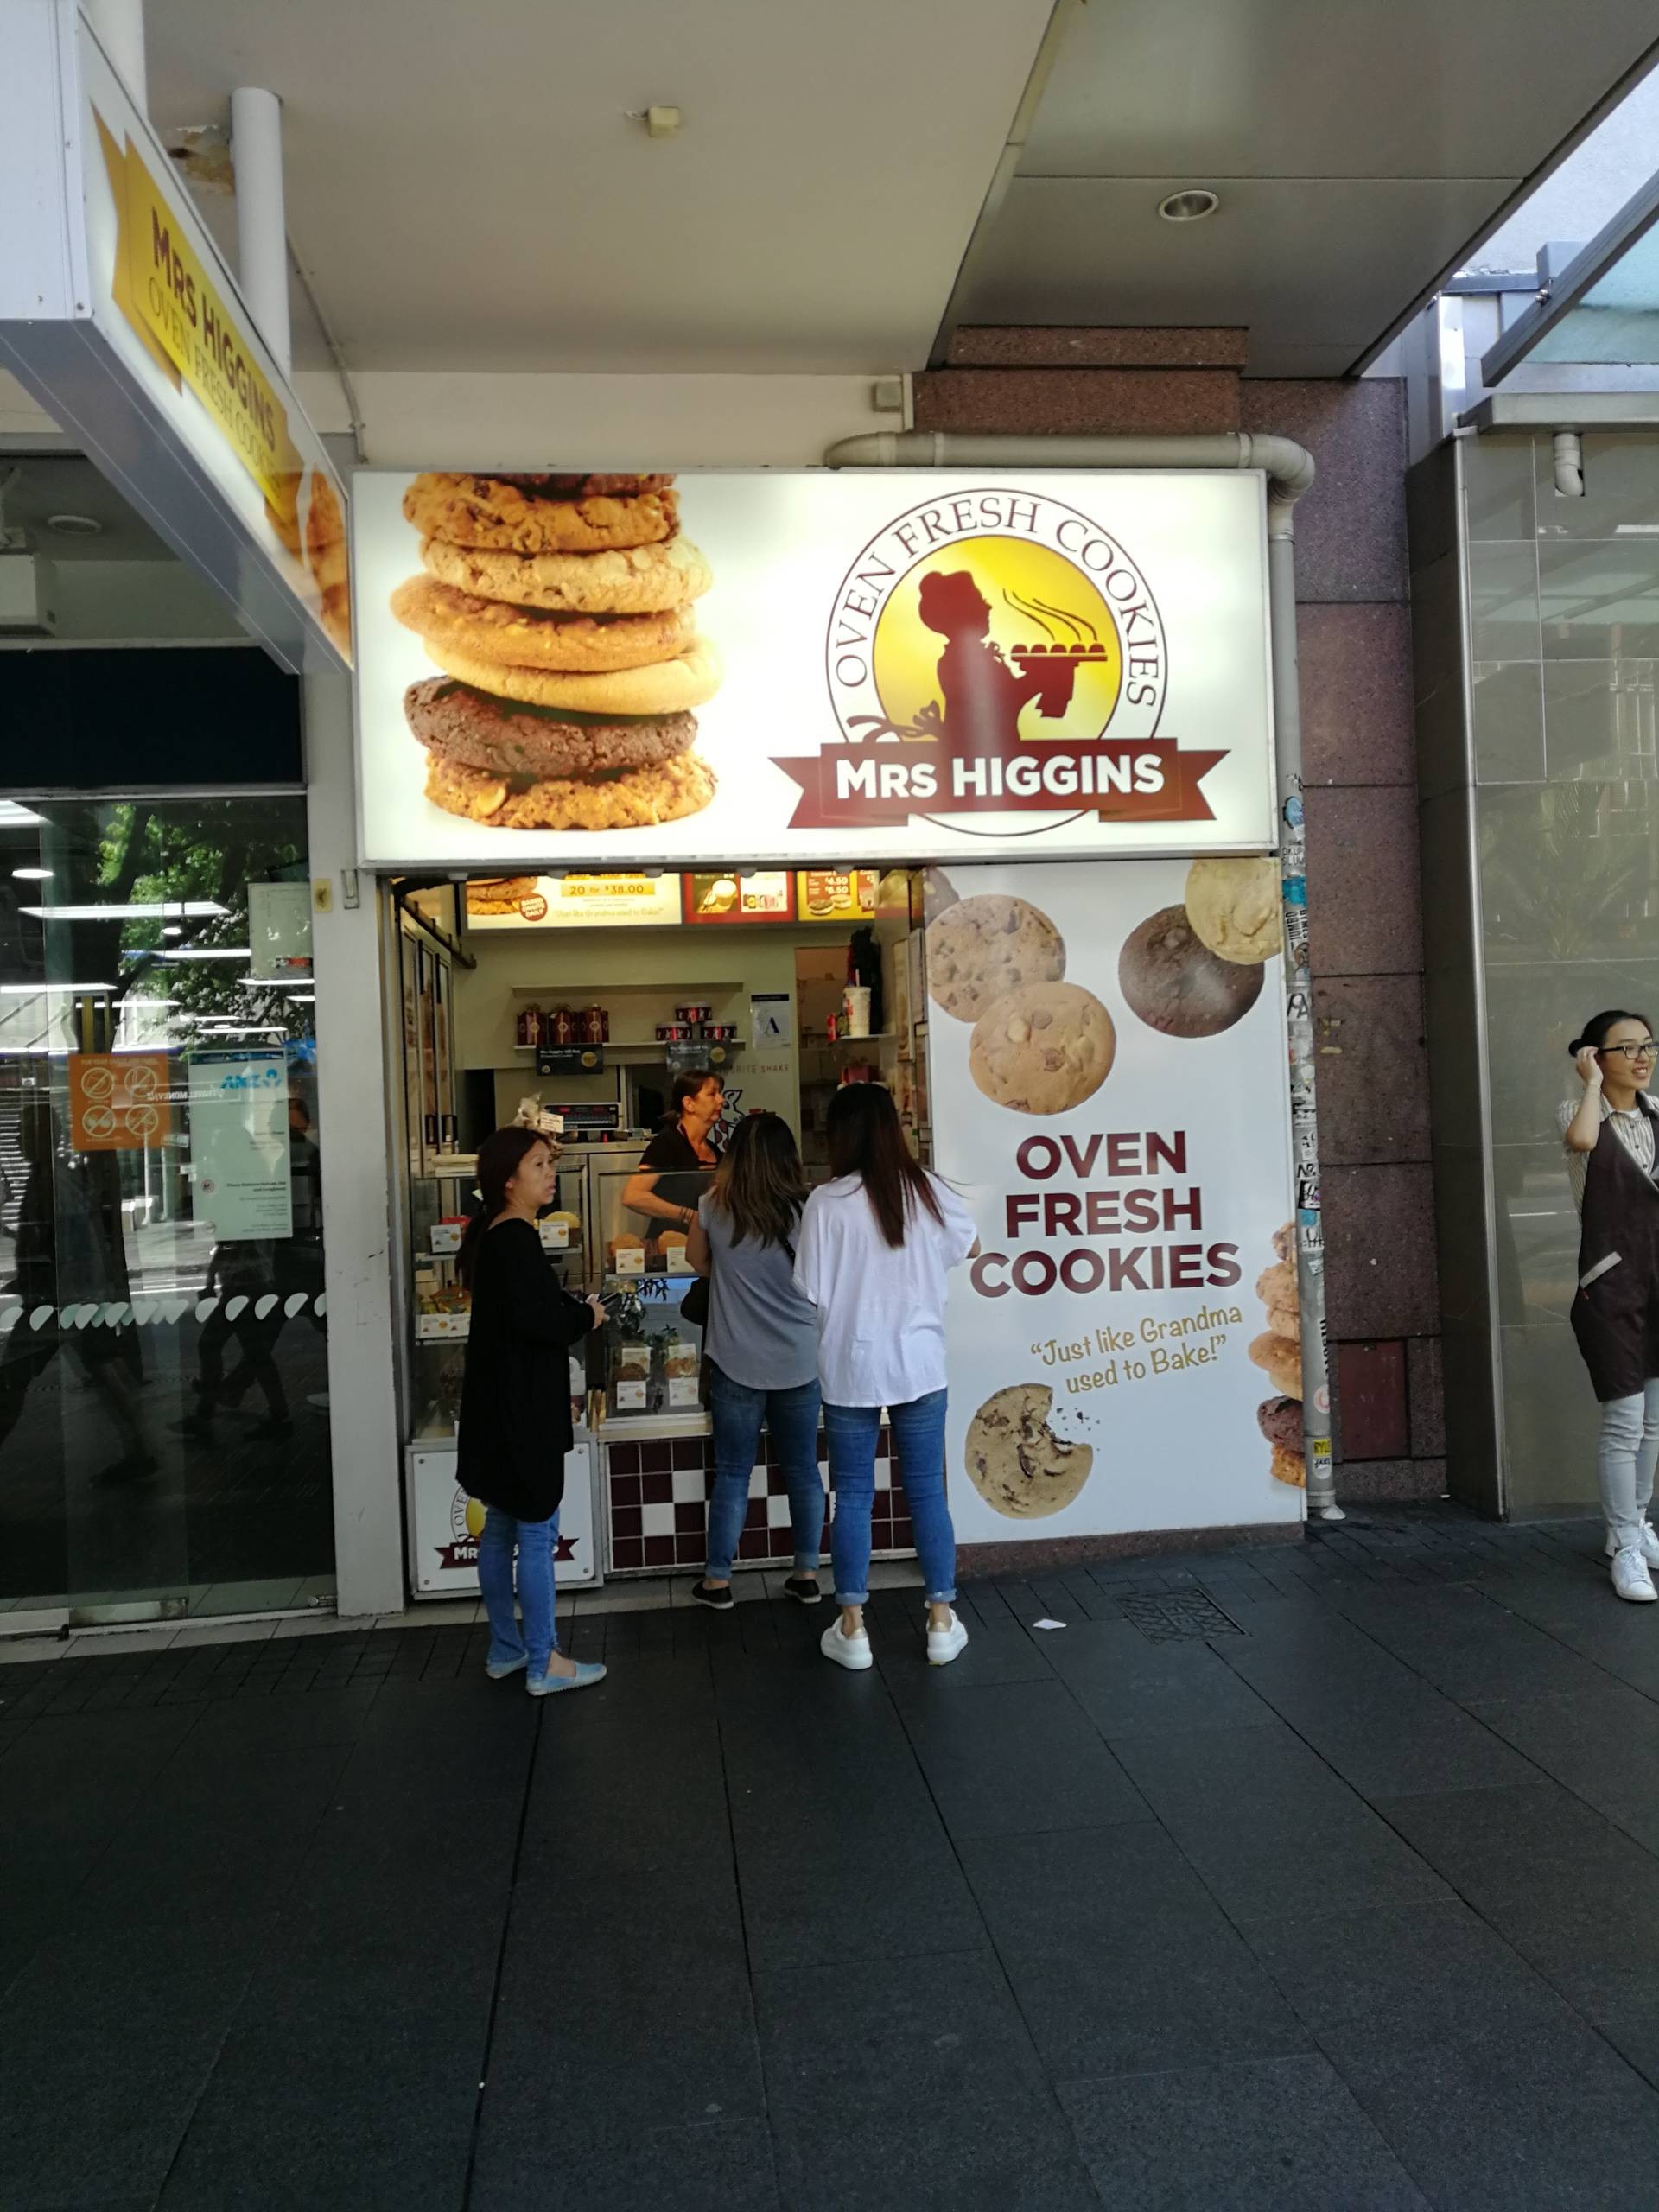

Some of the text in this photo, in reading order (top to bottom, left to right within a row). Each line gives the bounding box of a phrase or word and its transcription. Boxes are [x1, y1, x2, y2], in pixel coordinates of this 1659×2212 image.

[149, 276, 191, 365] OVEN
[194, 343, 233, 429] FRESH
[152, 206, 276, 452] MRS HIGGINS
[836, 497, 1160, 708] OVEN FRESH COOKIES
[953, 753, 1165, 797] HIGGINS
[570, 885, 585, 895] 20
[605, 885, 645, 894] $38.00
[760, 1064, 789, 1073] SHAKE
[1016, 1131, 1187, 1180] OVEN
[1006, 1187, 1203, 1238] FRESH
[970, 1242, 1243, 1298] COOKIES
[1095, 1325, 1135, 1355] like
[1140, 1305, 1243, 1342] Grandma
[1066, 1362, 1120, 1394] used
[1123, 1359, 1147, 1381] to
[454, 1488, 468, 1527] OVE
[454, 1545, 480, 1560] MR
